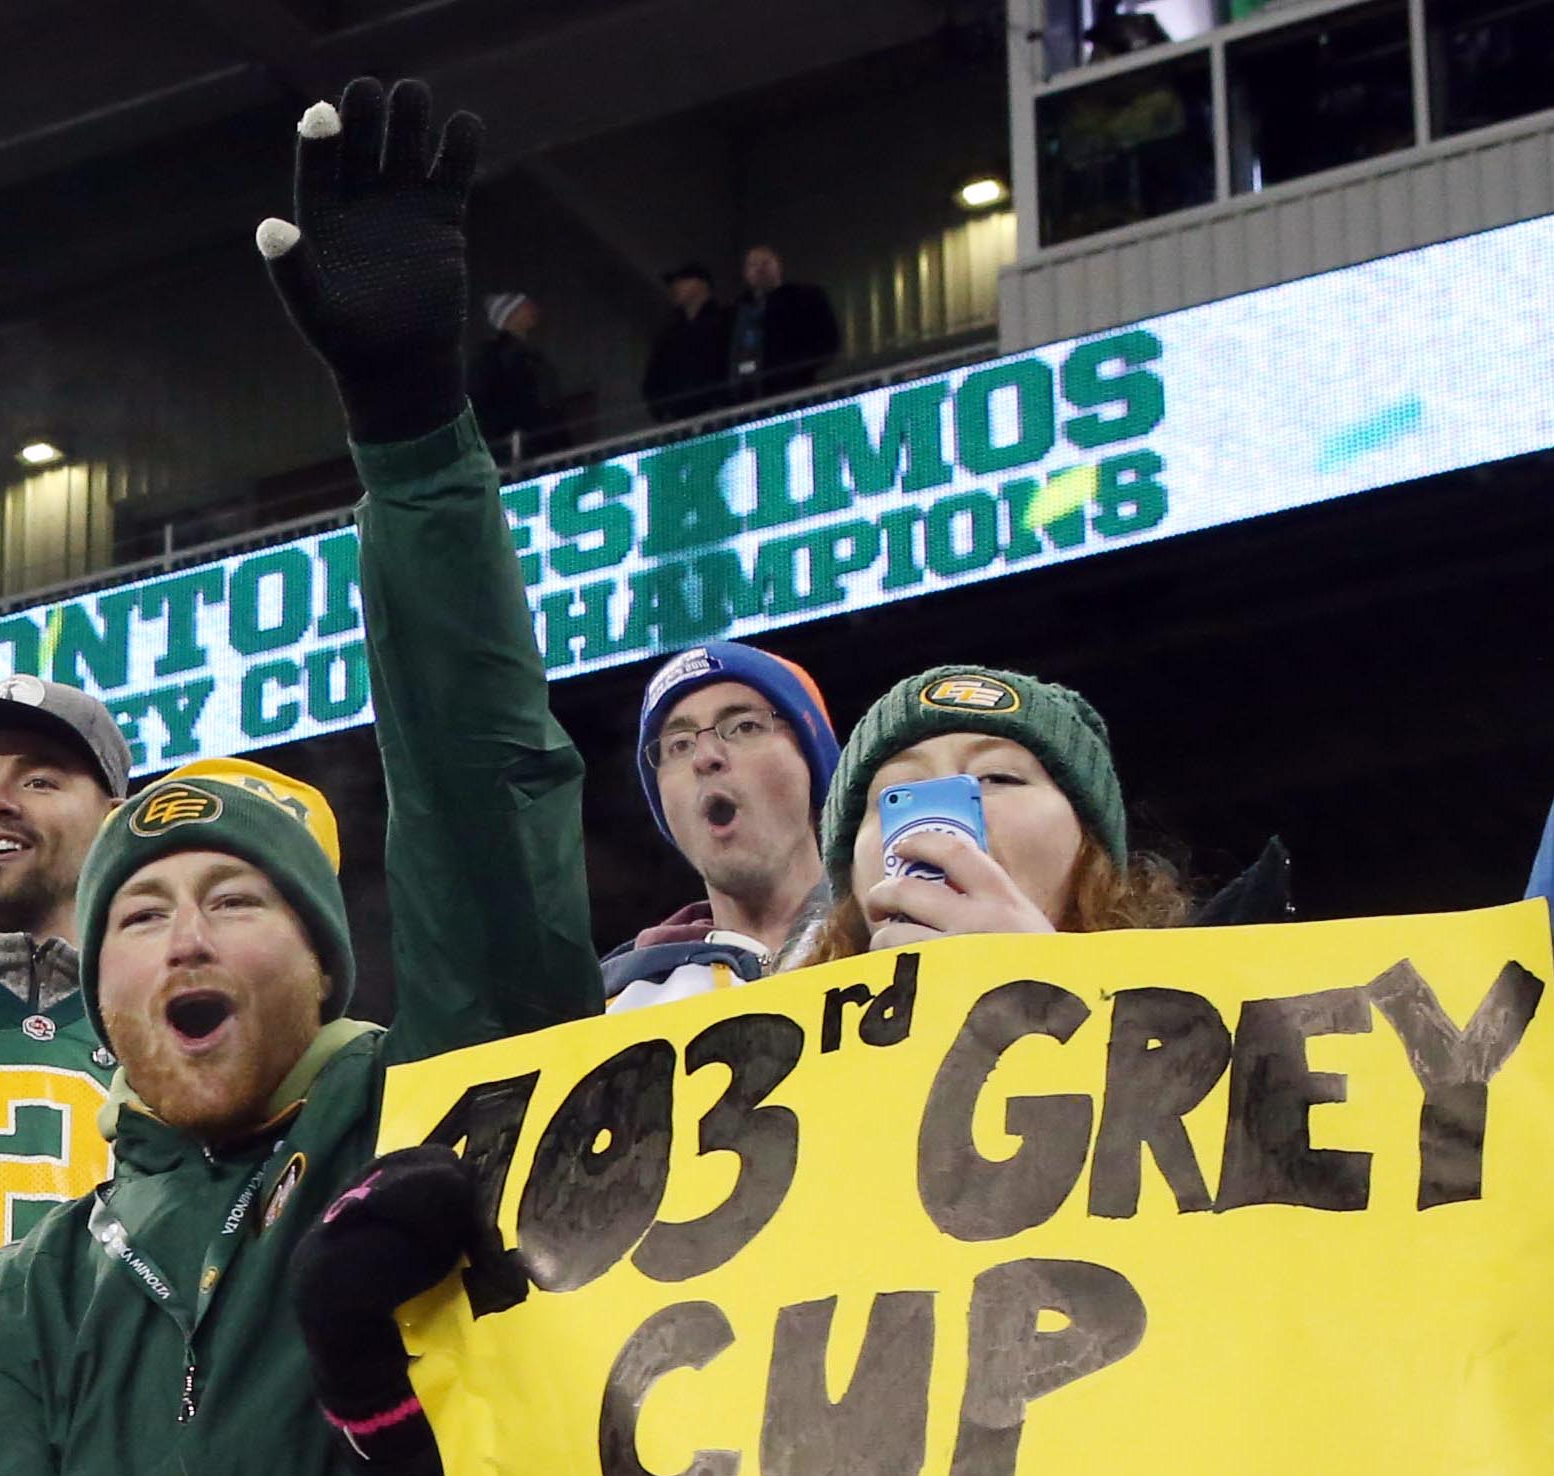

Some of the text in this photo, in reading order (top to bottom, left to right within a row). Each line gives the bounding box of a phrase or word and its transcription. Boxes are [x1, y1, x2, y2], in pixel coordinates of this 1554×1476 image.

[241, 640, 370, 739] CU
[535, 448, 1168, 669] HAMPIONS
[915, 957, 1546, 1243] GREY
[128, 1258, 172, 1300] MINOLTA
